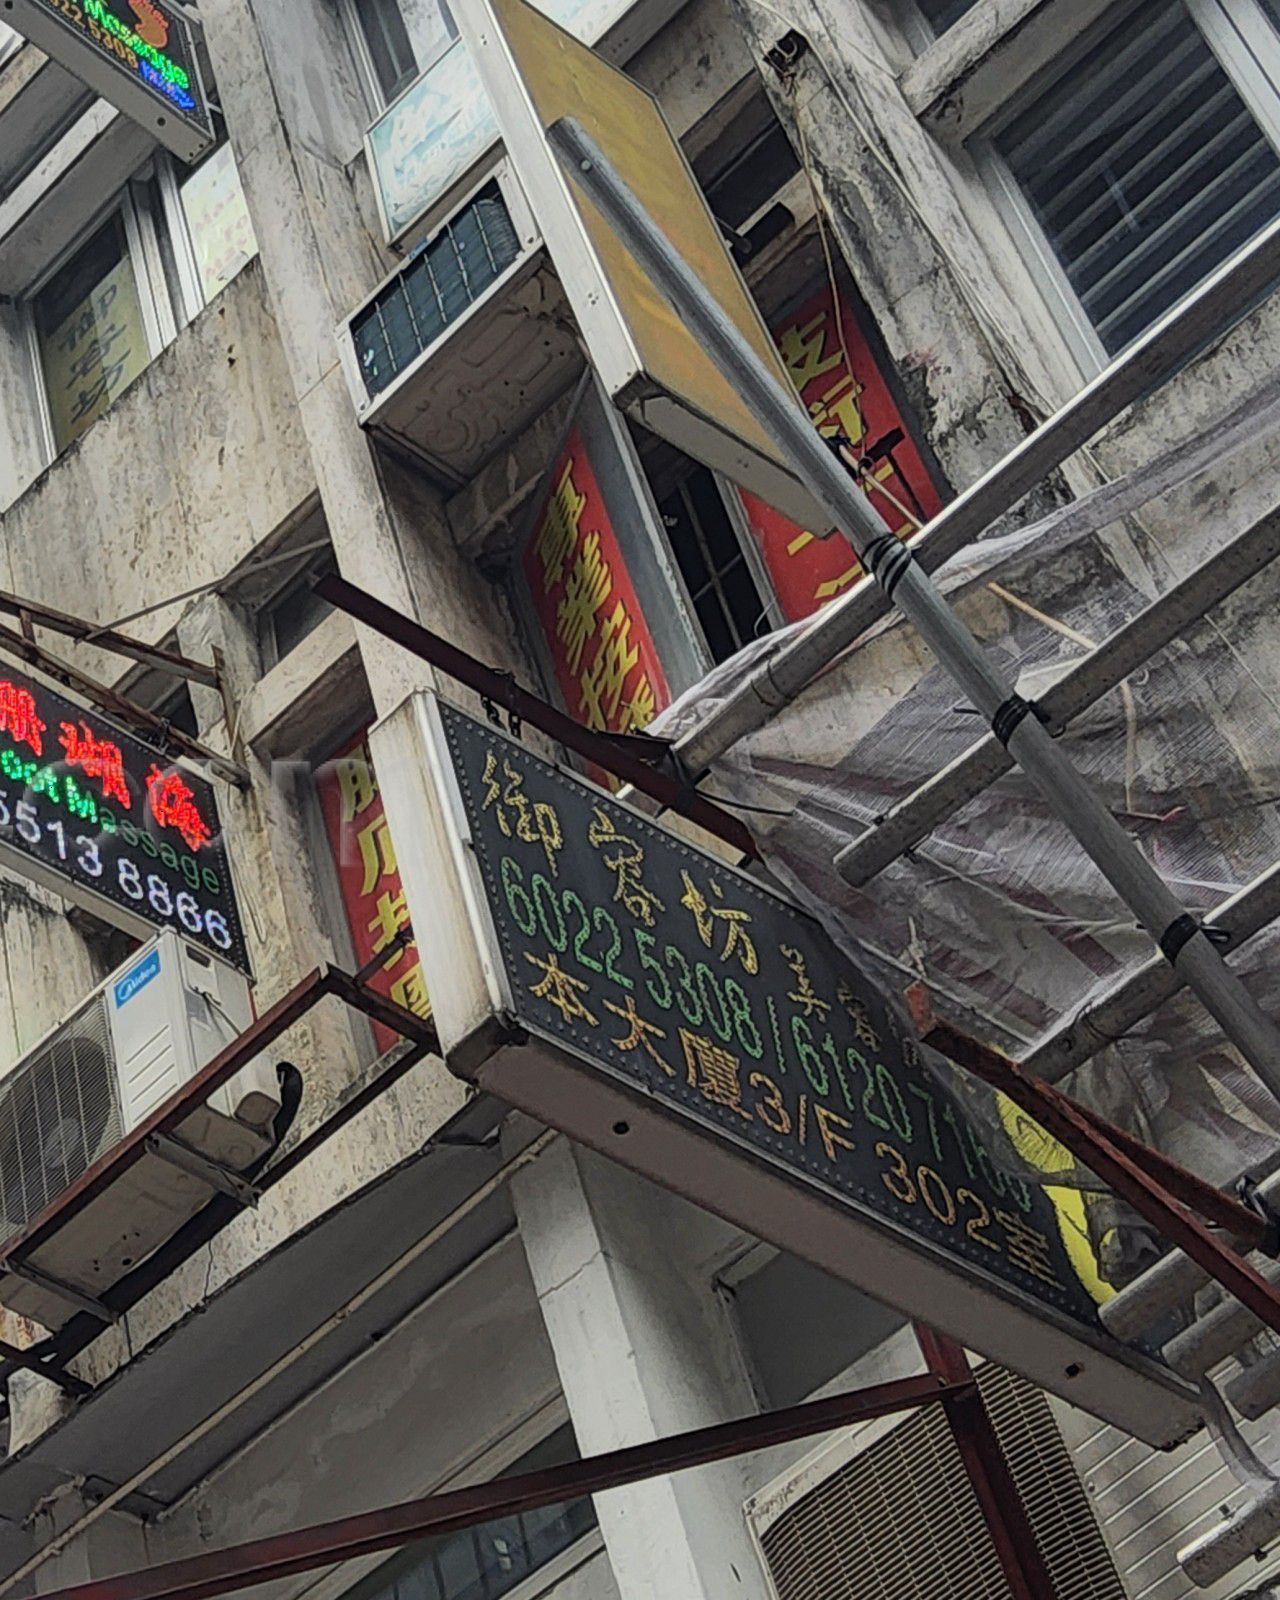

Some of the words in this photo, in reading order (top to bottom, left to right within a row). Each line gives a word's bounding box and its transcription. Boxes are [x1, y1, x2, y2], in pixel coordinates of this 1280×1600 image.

[64, 776, 220, 895] Massage
[117, 857, 233, 950] 8866
[480, 750, 760, 976] 御容坊
[500, 856, 632, 989] 6022
[634, 926, 763, 1060] 5308
[790, 1015, 913, 1144] 6120
